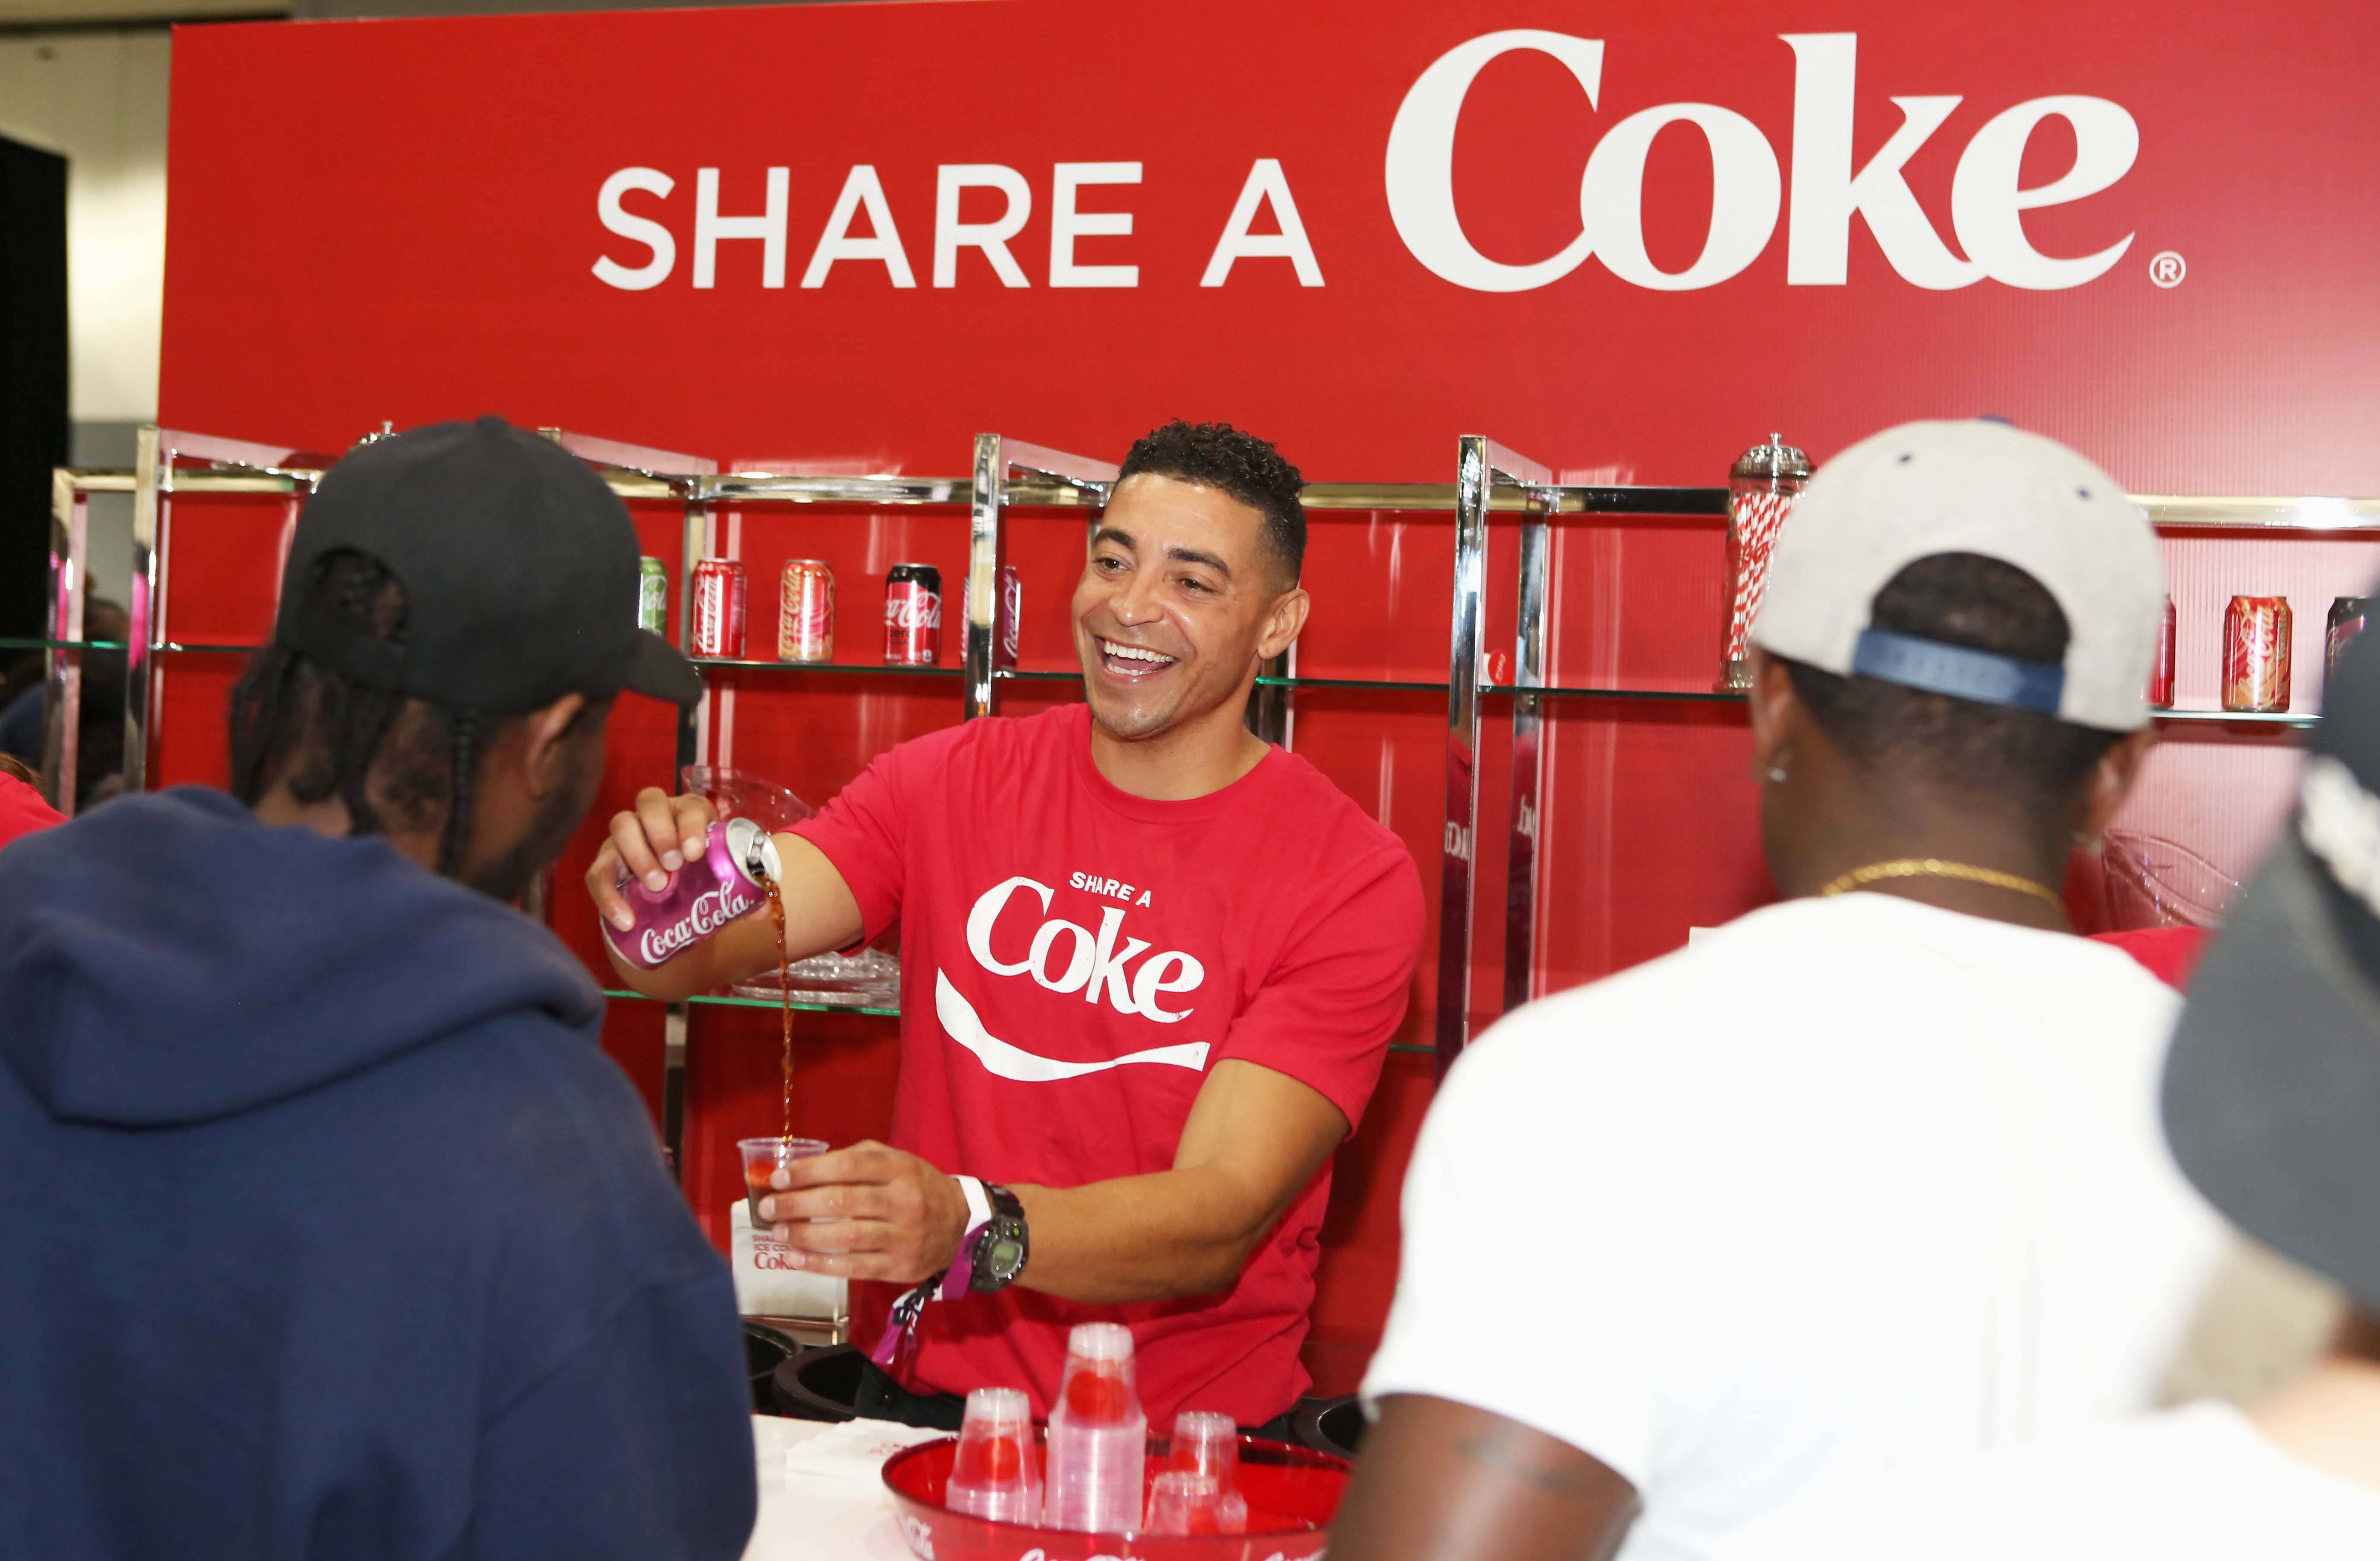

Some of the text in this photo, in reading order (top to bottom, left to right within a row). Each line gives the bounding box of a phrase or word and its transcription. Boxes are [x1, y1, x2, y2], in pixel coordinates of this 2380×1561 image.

[592, 162, 1142, 290] SHARE
[1201, 159, 1325, 287] A
[1386, 29, 2139, 292] Coke
[641, 877, 749, 964] Coca-Cola
[1069, 872, 1151, 908] SHARE A
[967, 876, 1205, 1023] Coke
